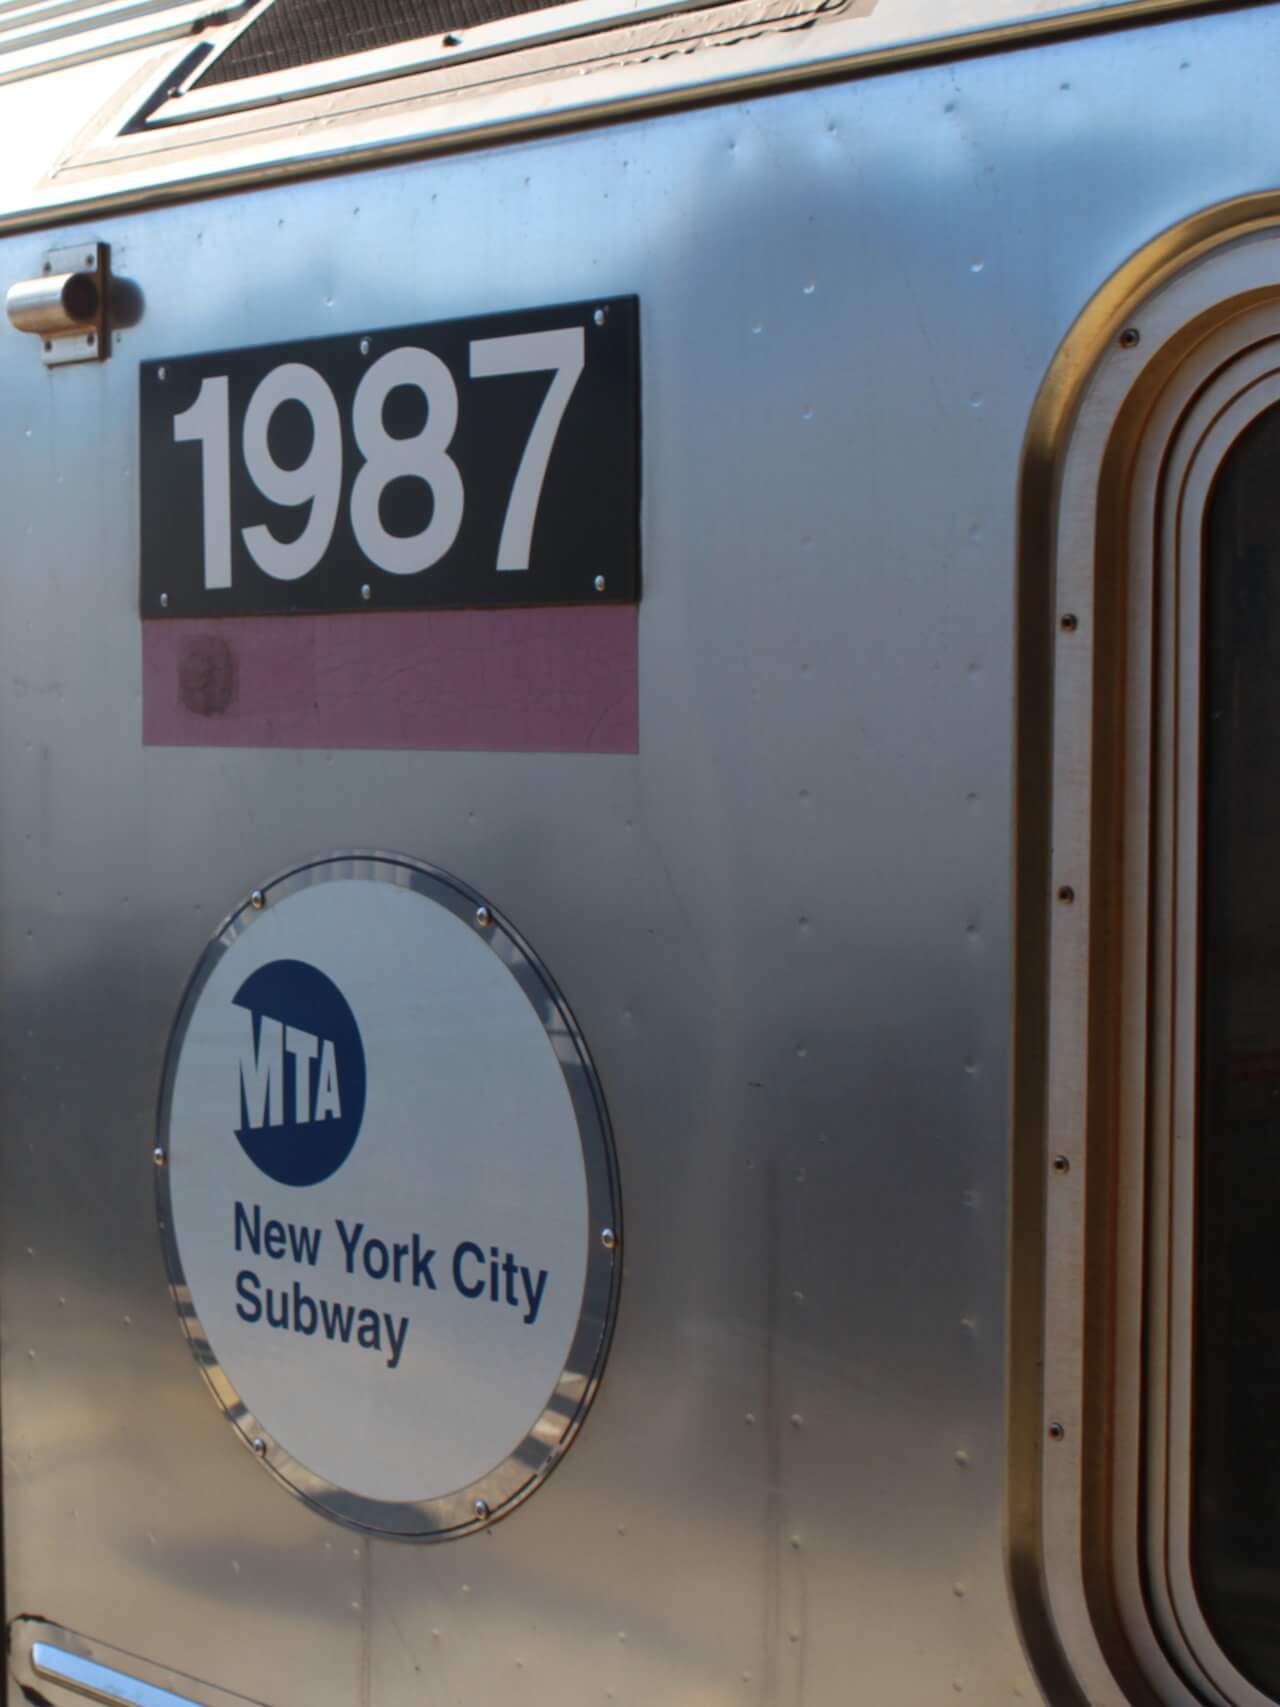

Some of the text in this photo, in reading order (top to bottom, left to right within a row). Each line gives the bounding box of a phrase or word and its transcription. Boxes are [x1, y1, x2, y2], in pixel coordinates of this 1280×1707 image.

[173, 326, 585, 590] 1987
[232, 1001, 342, 1131] MTA
[233, 1201, 549, 1325] New York City
[235, 1269, 410, 1369] Subway
